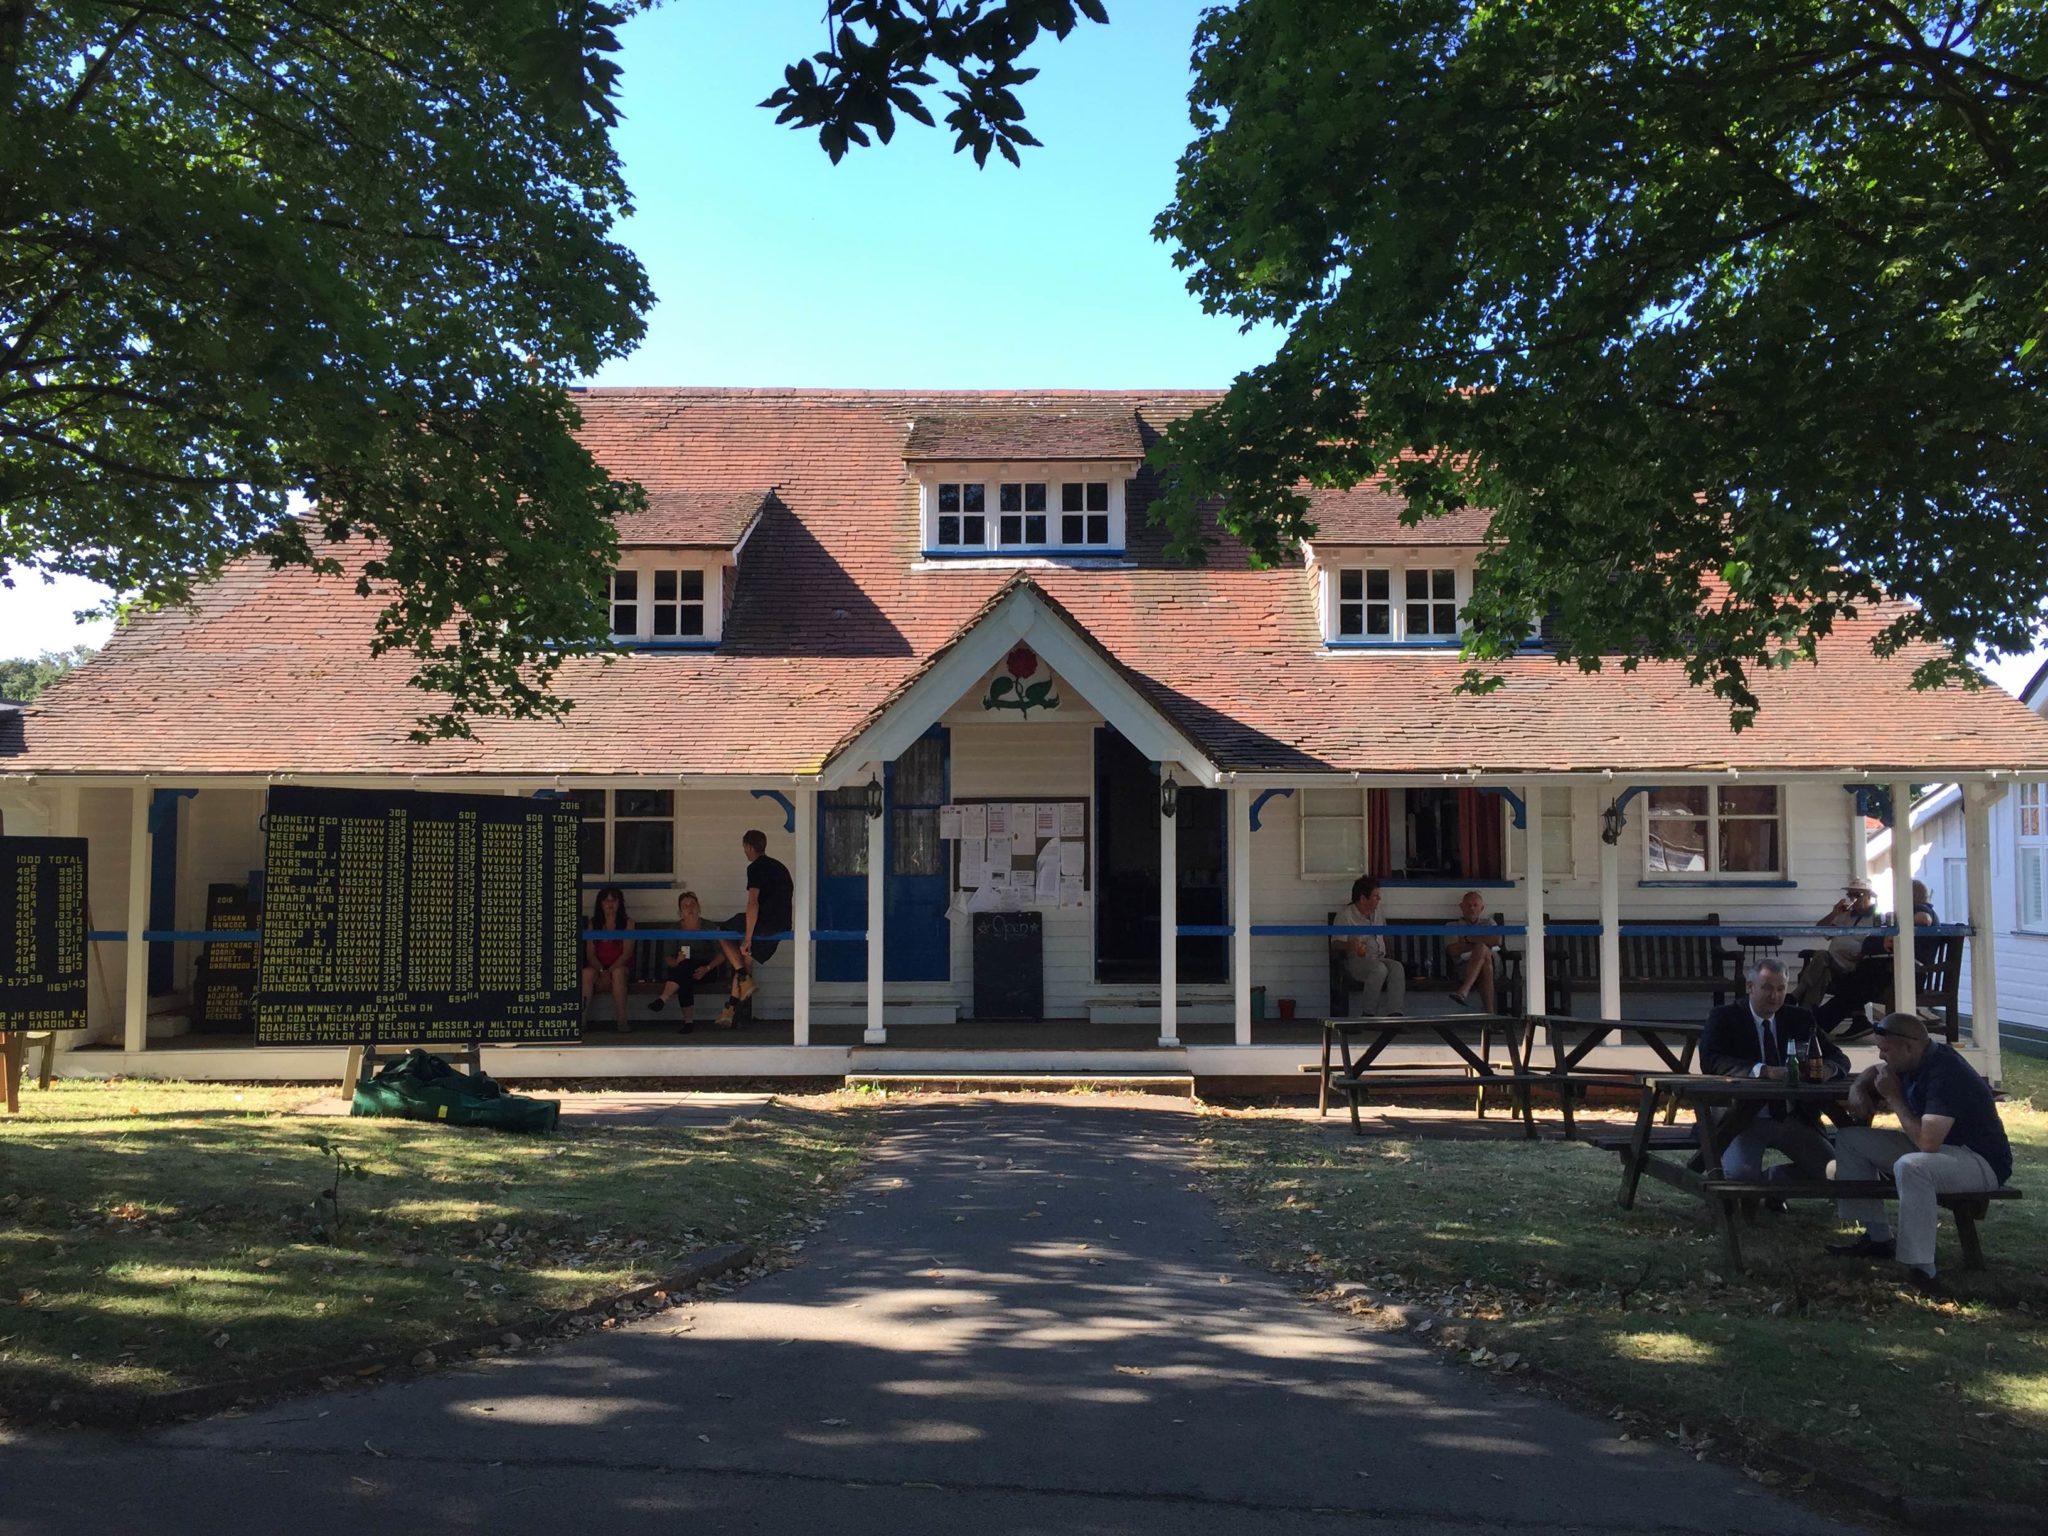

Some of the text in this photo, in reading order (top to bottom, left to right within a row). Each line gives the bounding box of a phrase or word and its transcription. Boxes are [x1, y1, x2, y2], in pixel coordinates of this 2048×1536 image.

[271, 815, 316, 824] BARNETT
[389, 809, 580, 824] 300 500 600 TOTAL
[271, 824, 315, 833] LUCKMAN
[270, 833, 308, 842] WEEDEN
[269, 841, 294, 850] ROSE
[269, 850, 327, 860] UNDERWOOD
[16, 856, 83, 864] 1000 TOTAL
[268, 859, 300, 867] EAYRS
[268, 867, 313, 876] CROWSON
[317, 868, 336, 877] LAE
[267, 876, 290, 884] NICE
[267, 894, 306, 902] HOWARD
[316, 894, 334, 903] HAD
[266, 912, 324, 921] BIRTWISTLE
[265, 920, 311, 929] WHEELER
[265, 929, 304, 938] OSMOND
[264, 938, 297, 947] PURDY
[264, 947, 323, 956] WARBURTON
[263, 957, 322, 965] ARMSTRONG
[263, 965, 315, 974] DRYSDALE
[262, 974, 308, 983] COLEMAN
[262, 984, 310, 992] RAINCOCK
[315, 984, 334, 992] TJD
[261, 1005, 303, 1013] CAPTAIN
[386, 1004, 416, 1012] ALLEN
[507, 1006, 536, 1014] TOTAL
[11, 1012, 24, 1020] JH
[29, 1011, 64, 1020] ENSOR
[260, 1015, 283, 1023] MAIN
[287, 1014, 320, 1022] COACH
[326, 1014, 374, 1022] RICHARDS
[10, 1021, 17, 1029] R
[29, 1020, 75, 1029] HARDING
[260, 1024, 306, 1032] COACHES
[310, 1023, 355, 1031] LANGLEY
[378, 1022, 416, 1030] NELSON
[432, 1021, 469, 1029] MESSER
[473, 1021, 484, 1029] JH
[490, 1021, 524, 1029] MILTON
[539, 1020, 568, 1028] ENSOR
[259, 1033, 312, 1041] RESERVES
[317, 1032, 355, 1040] TAYLOR
[378, 1031, 409, 1040] CLARK
[426, 1030, 472, 1038] BROOKING
[488, 1030, 512, 1038] COOK
[524, 1029, 570, 1037] SKELLETT
